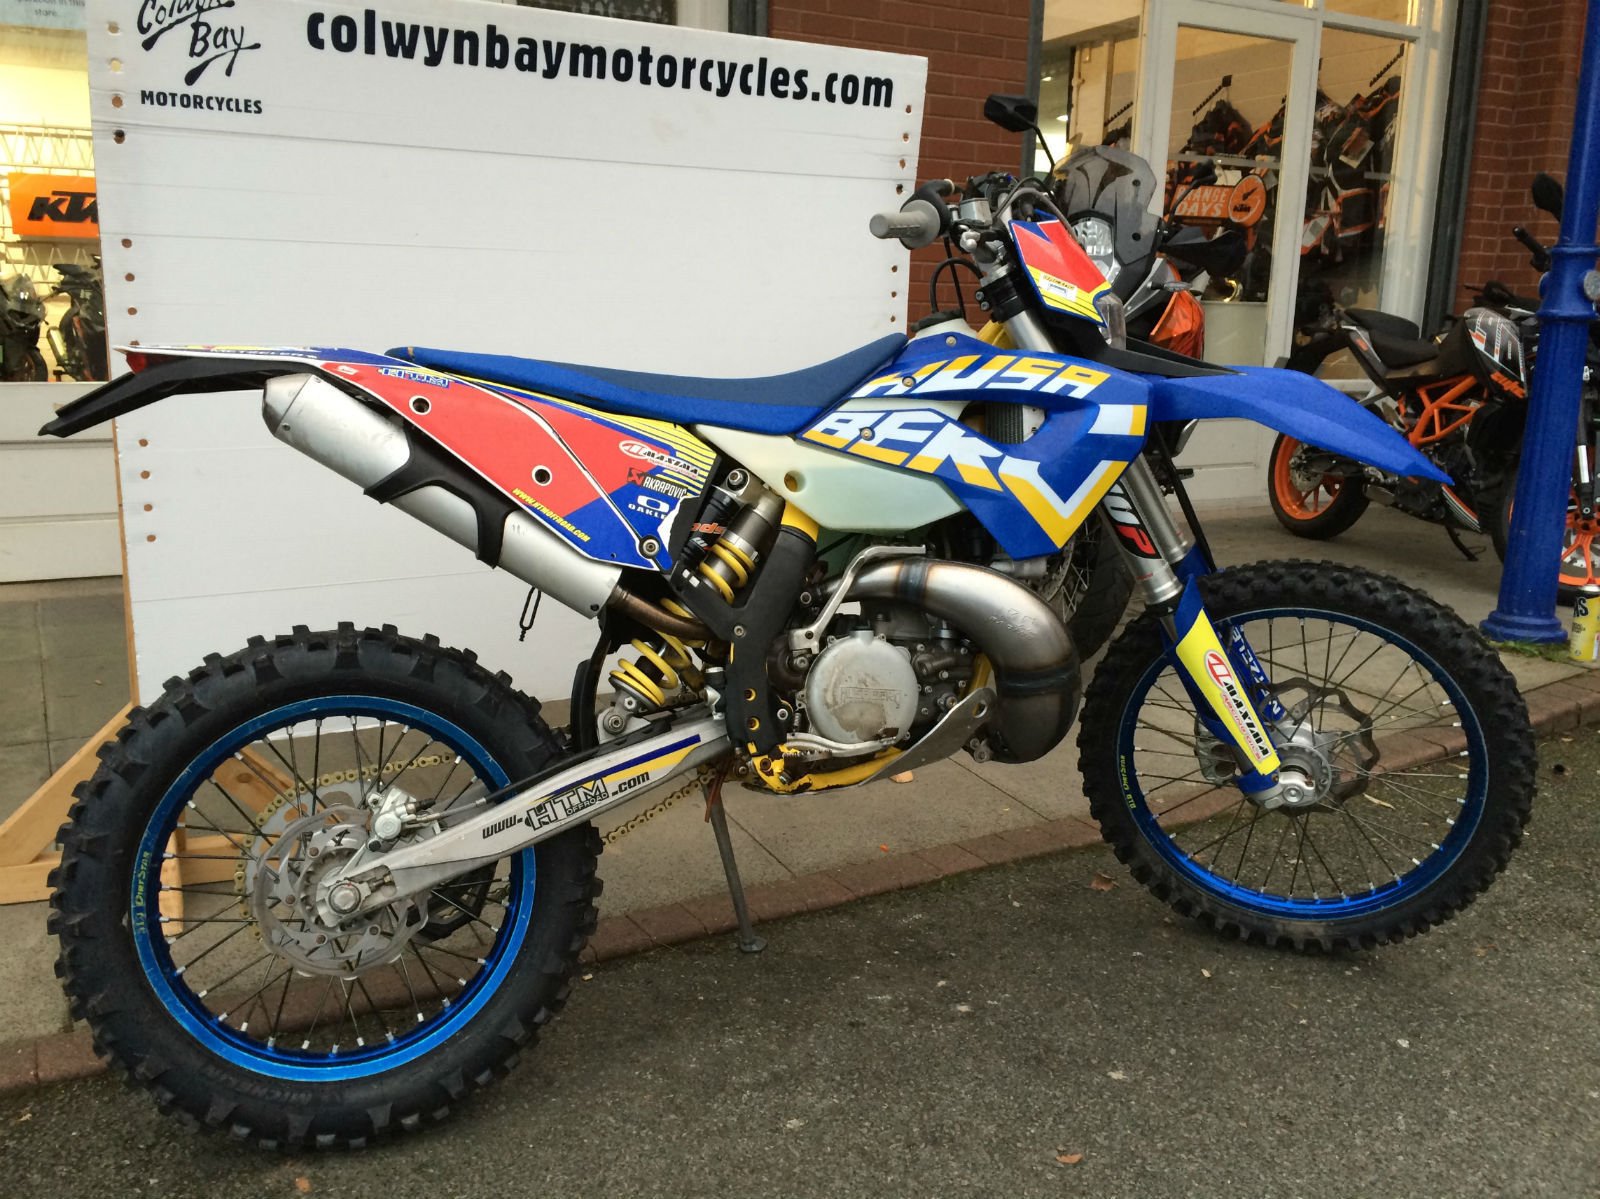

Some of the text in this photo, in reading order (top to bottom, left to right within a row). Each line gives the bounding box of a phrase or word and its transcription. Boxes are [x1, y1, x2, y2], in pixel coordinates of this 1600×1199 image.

[184, 21, 261, 86] Bay
[306, 9, 895, 108] colwynbaymotorcycles.com
[140, 90, 263, 115] MOTORCYCLES
[1175, 201, 1224, 216] DAYS
[643, 450, 699, 475] MAXIMA
[1222, 680, 1271, 758] MAXIMA
[566, 791, 609, 816] OFFROAD
